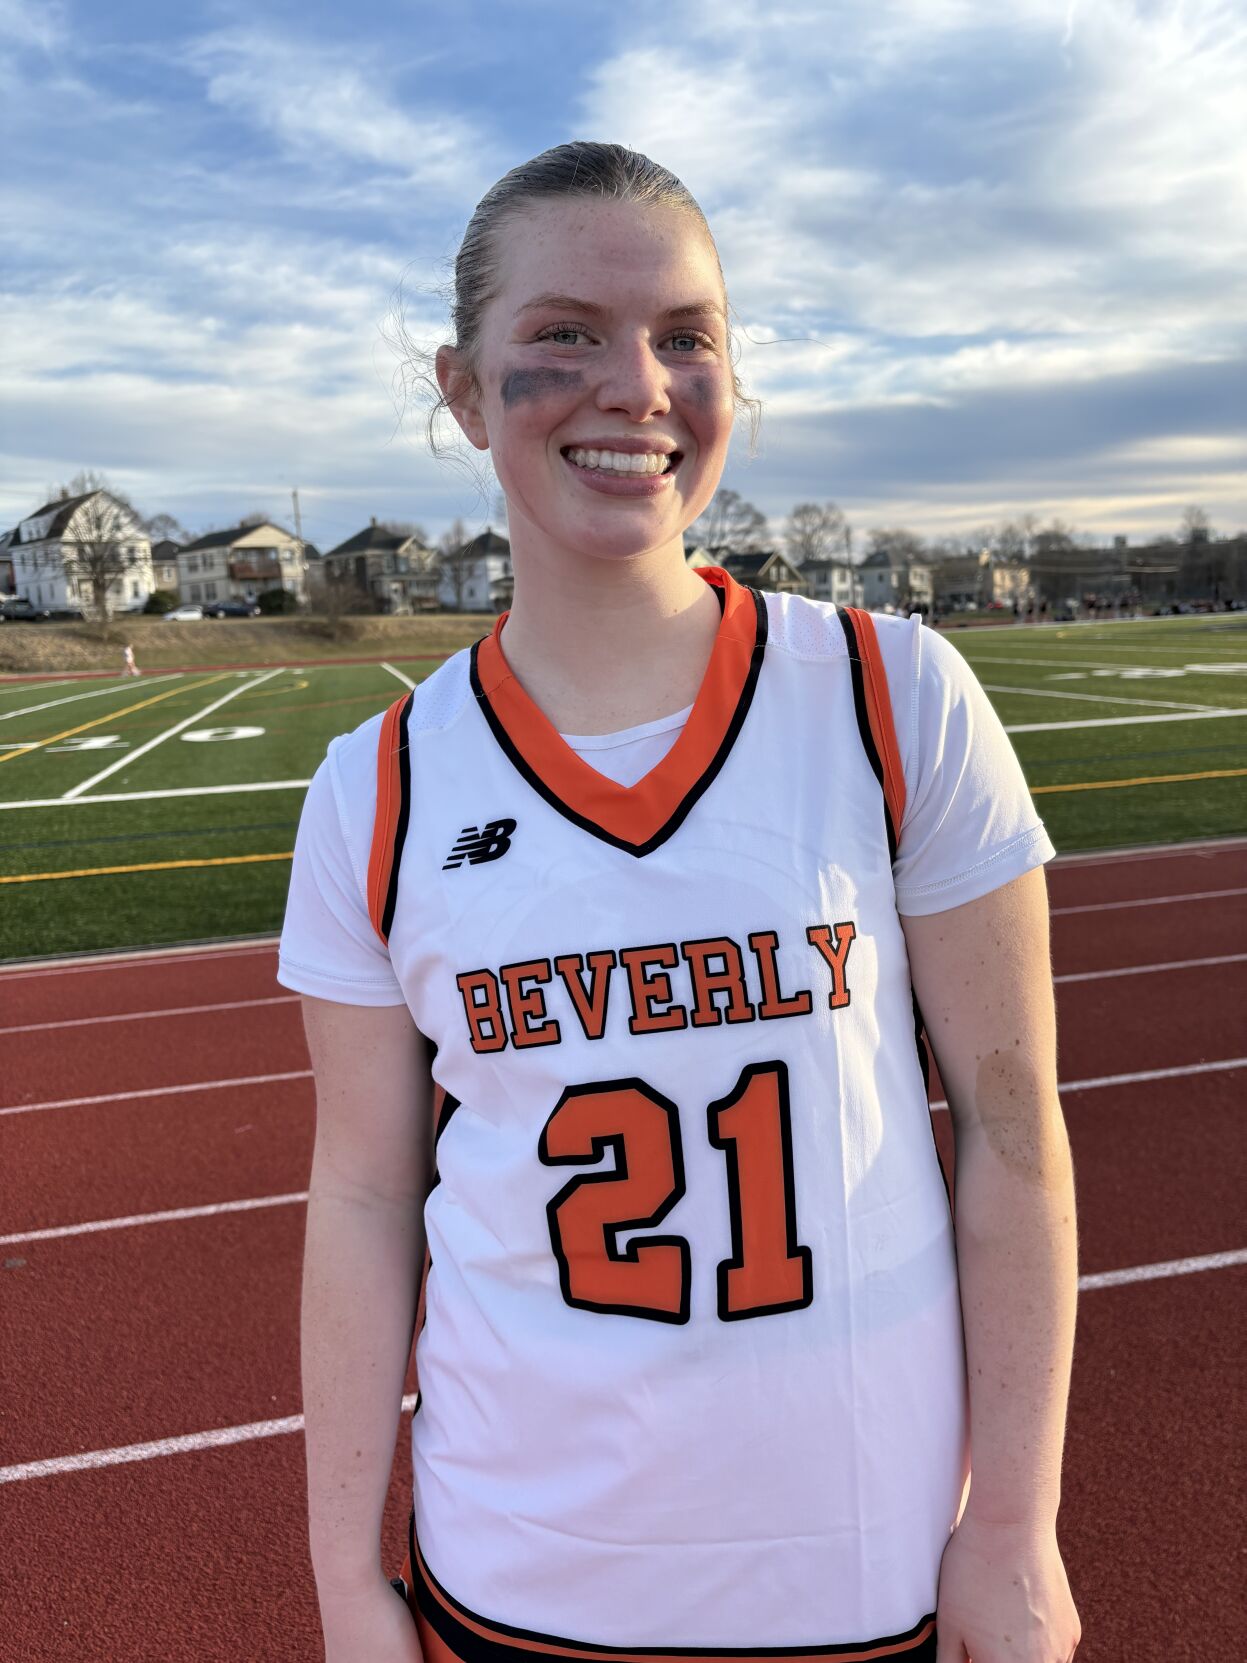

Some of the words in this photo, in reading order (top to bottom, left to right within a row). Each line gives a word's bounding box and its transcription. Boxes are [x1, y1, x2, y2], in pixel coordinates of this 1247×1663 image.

[441, 818, 517, 870] NB
[456, 921, 857, 1054] BEVERLY
[537, 1059, 814, 1326] 21
